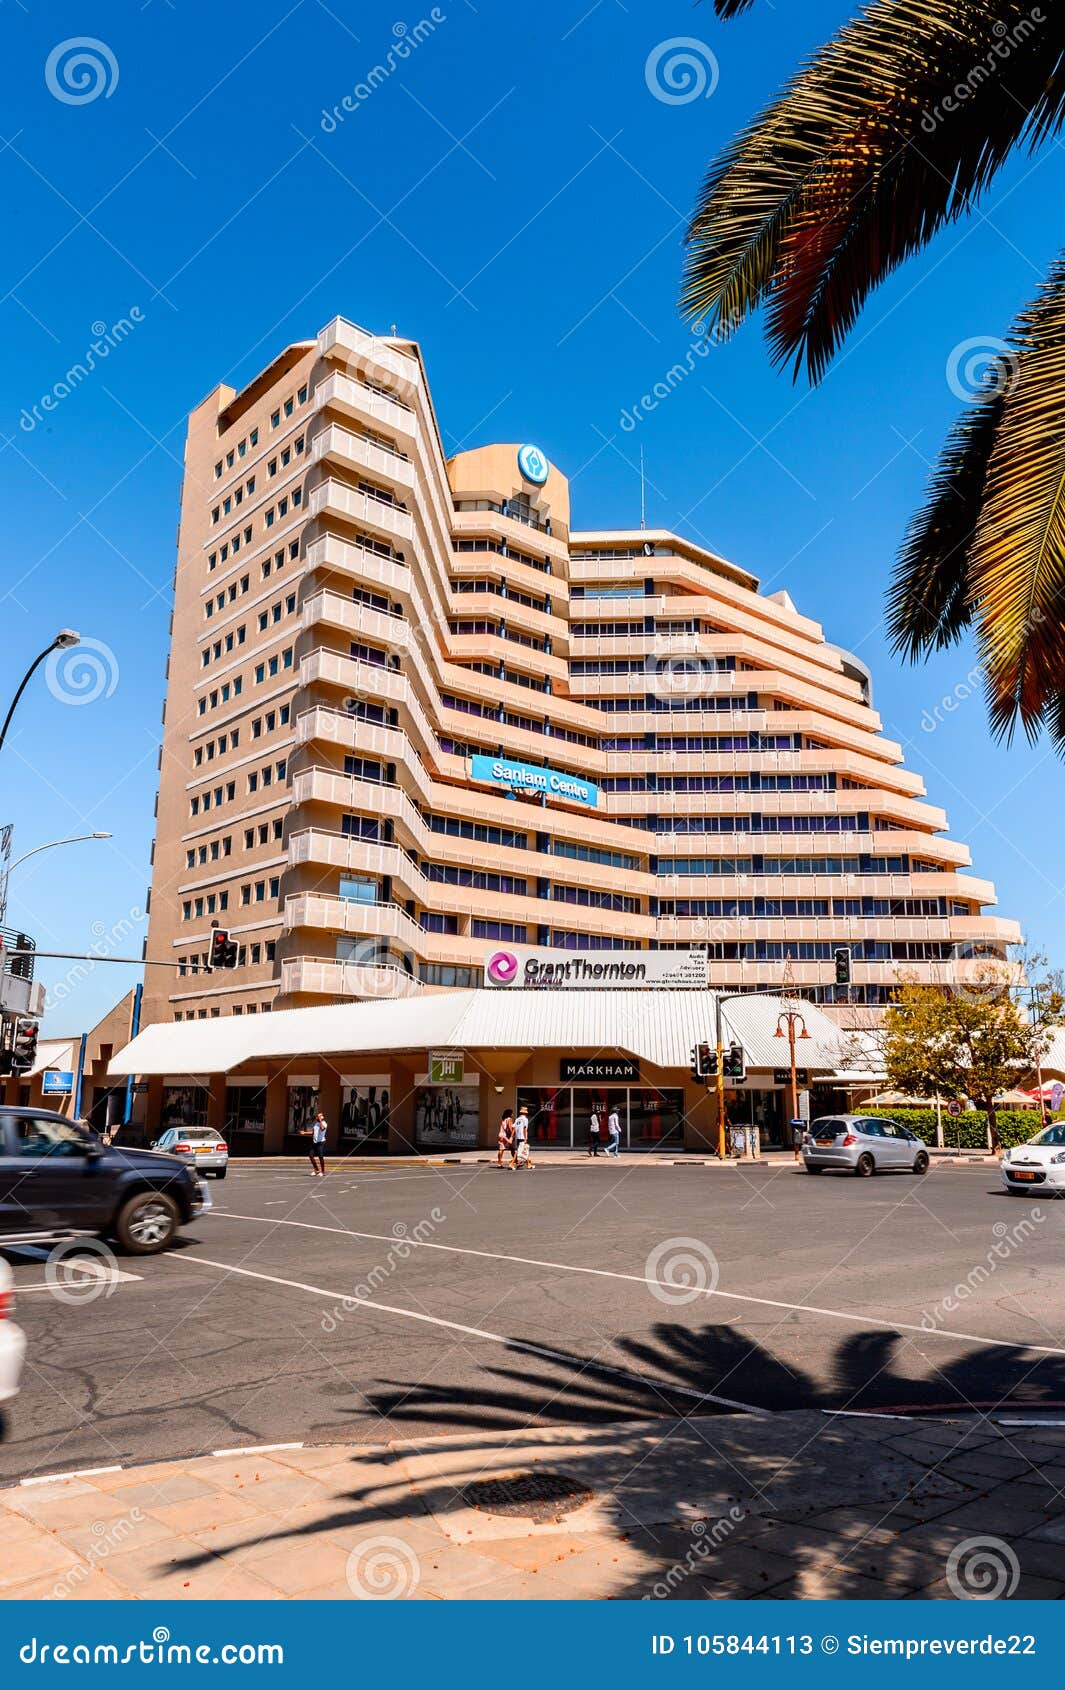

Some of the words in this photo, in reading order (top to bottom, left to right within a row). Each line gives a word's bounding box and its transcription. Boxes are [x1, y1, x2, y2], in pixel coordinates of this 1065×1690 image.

[492, 762, 547, 788] Sanlam
[549, 775, 588, 799] Centre
[440, 1061, 455, 1077] JHI
[567, 1065, 633, 1075] MARKHAM
